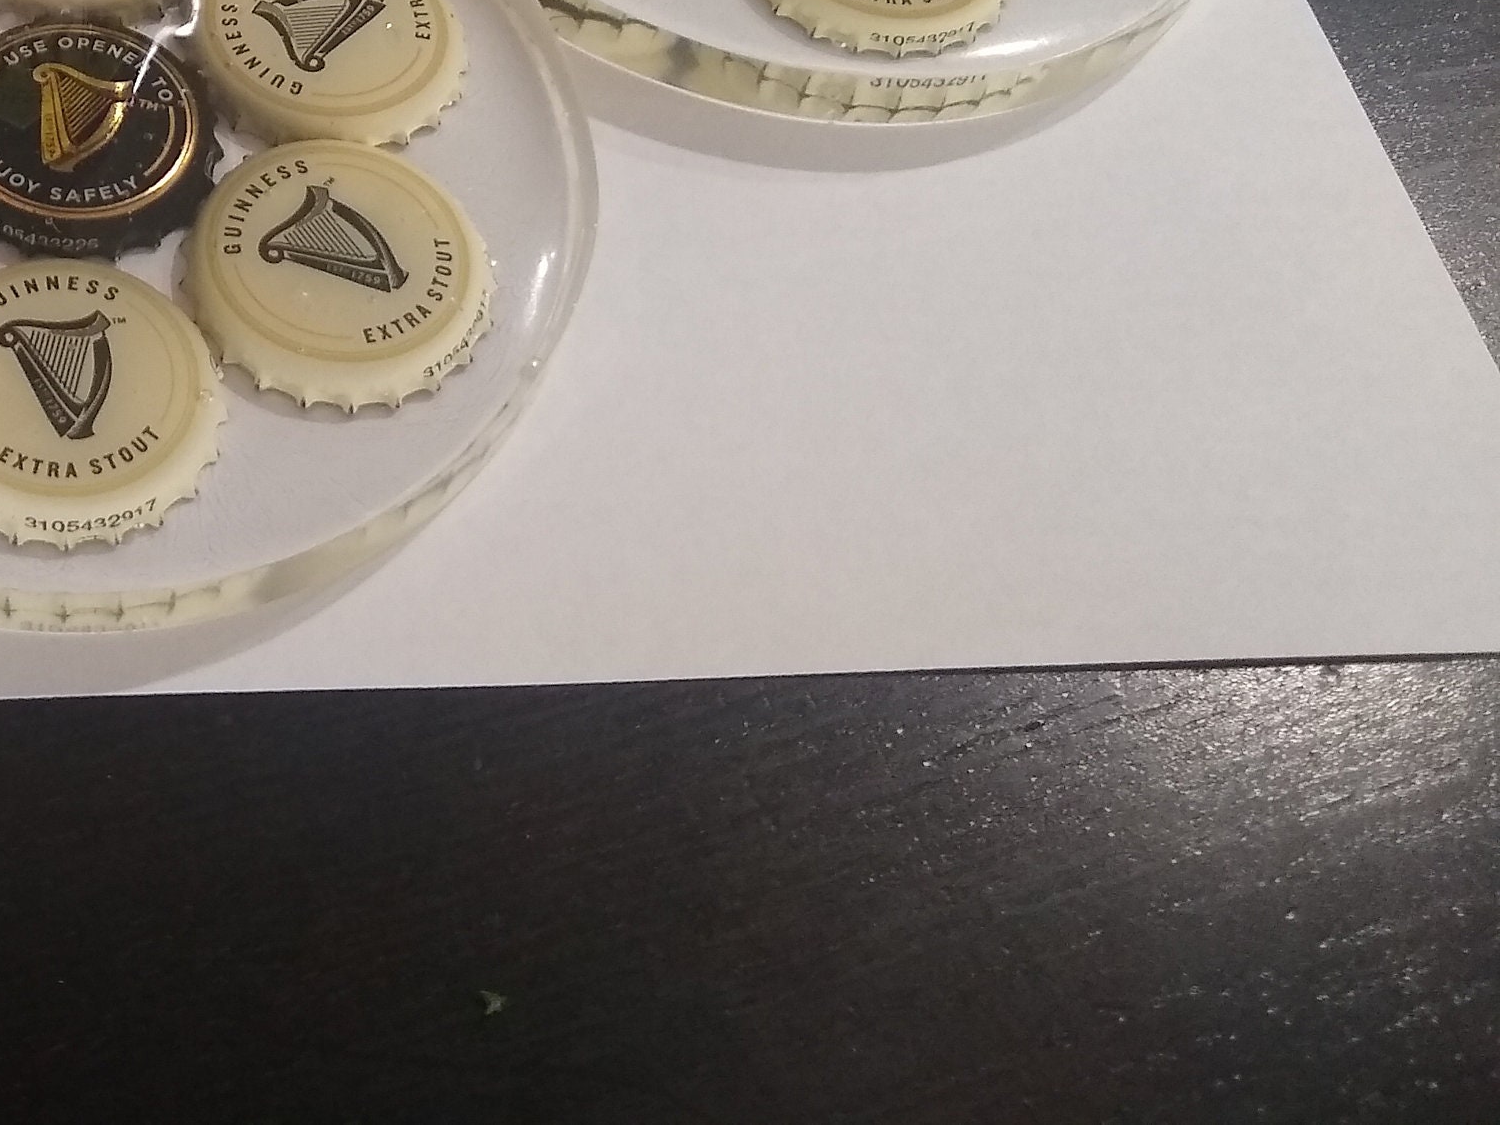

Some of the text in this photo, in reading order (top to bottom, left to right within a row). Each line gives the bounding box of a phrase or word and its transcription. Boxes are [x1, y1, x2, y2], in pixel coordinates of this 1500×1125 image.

[3, 39, 48, 66] USE
[151, 76, 174, 102] TO
[221, 3, 303, 95] GUINNESS
[50, 175, 139, 202] SAFELY
[224, 160, 308, 256] GUINNESS
[363, 238, 452, 344] EXTRA STOUT
[90, 425, 160, 475] STOUT
[24, 498, 157, 532] 3105432917
